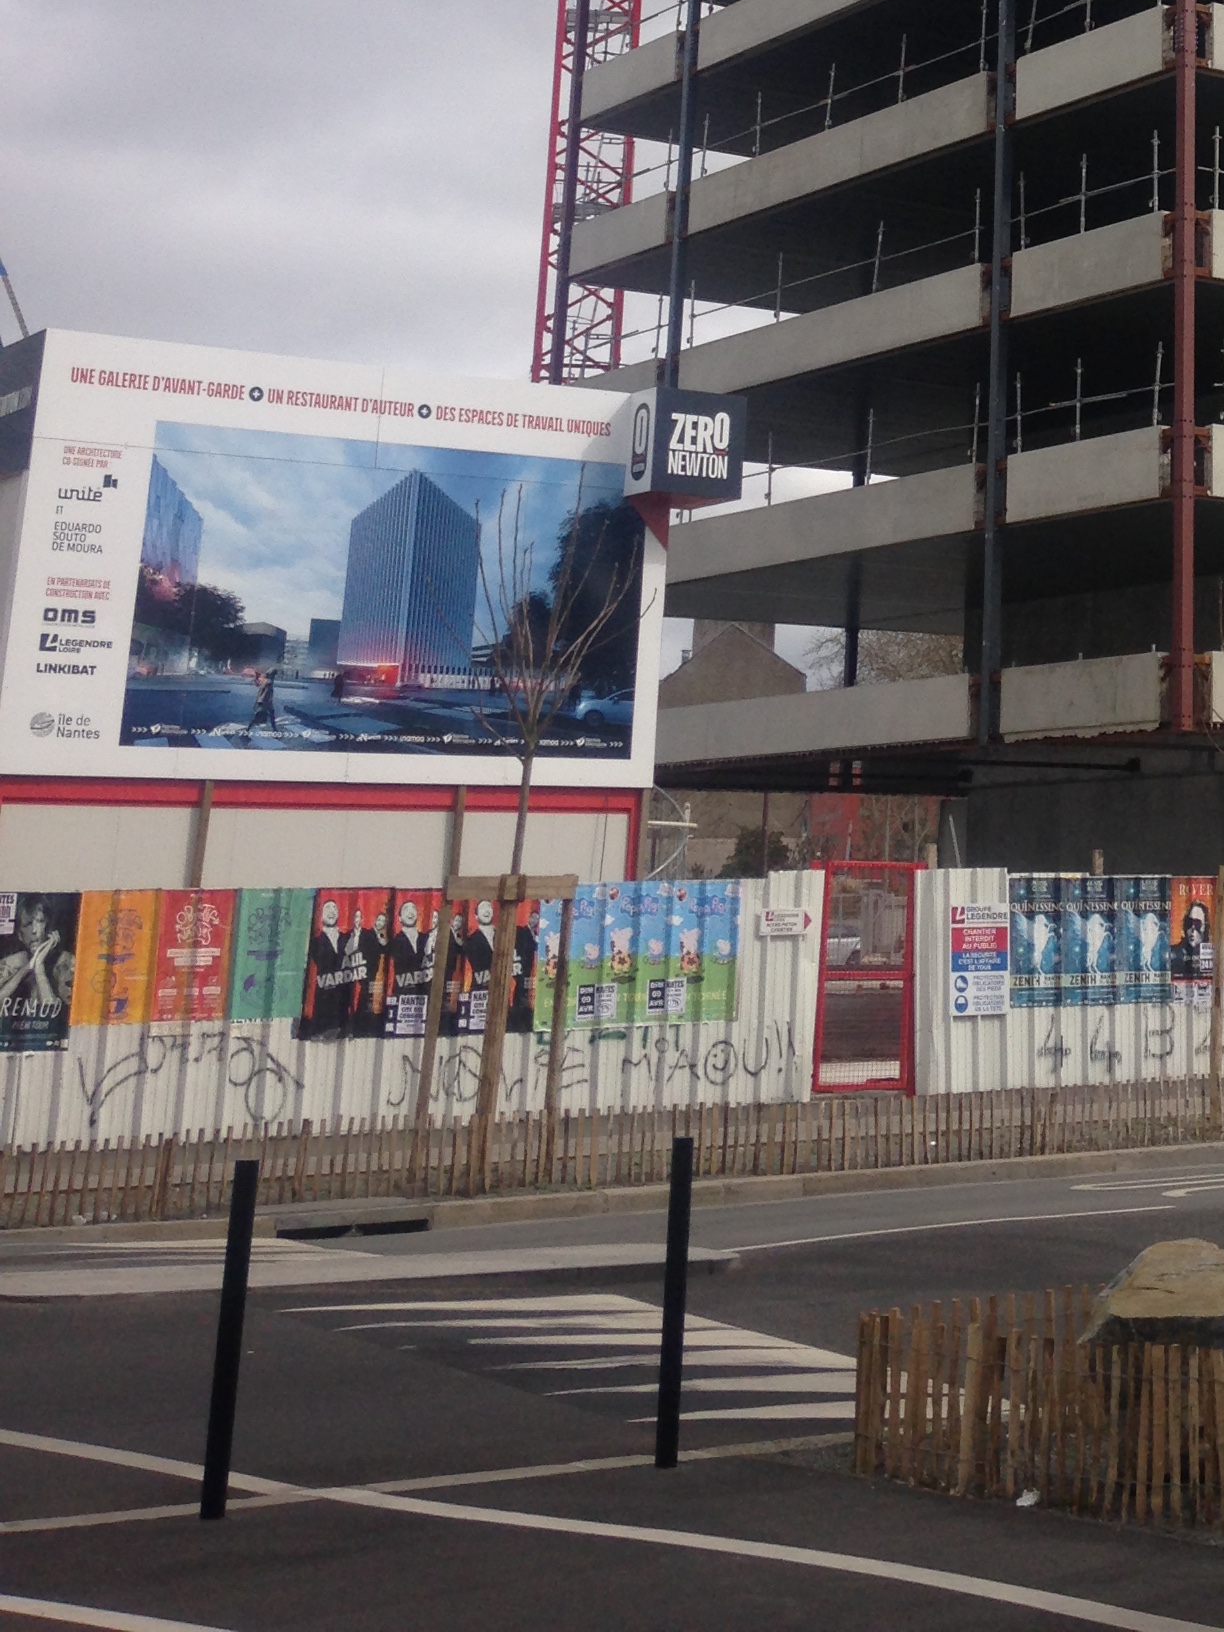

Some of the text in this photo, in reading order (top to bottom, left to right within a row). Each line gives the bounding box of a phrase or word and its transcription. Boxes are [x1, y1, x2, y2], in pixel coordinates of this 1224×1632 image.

[71, 367, 246, 401] UNE GALERIE D'AVANT-GARDE
[267, 387, 415, 418] UN RESTAURANT D'AUTEUR
[436, 405, 612, 438] DES ESPACES DE TRAVAIL UNIQUES
[669, 411, 731, 454] ZERO
[667, 450, 729, 480] NEWTON
[56, 505, 64, 515] ET
[54, 521, 102, 534] EDUARDO
[53, 531, 87, 543] SOUTO
[51, 541, 103, 554] DE MOURA
[59, 638, 113, 649] LEGENDRE
[36, 663, 97, 675] LINKIBAT
[76, 714, 91, 726] de
[56, 726, 101, 739] Nantes
[966, 912, 1008, 921] LEGENDRE
[316, 966, 367, 988] VARDAR
[649, 999, 664, 1008] AVR
